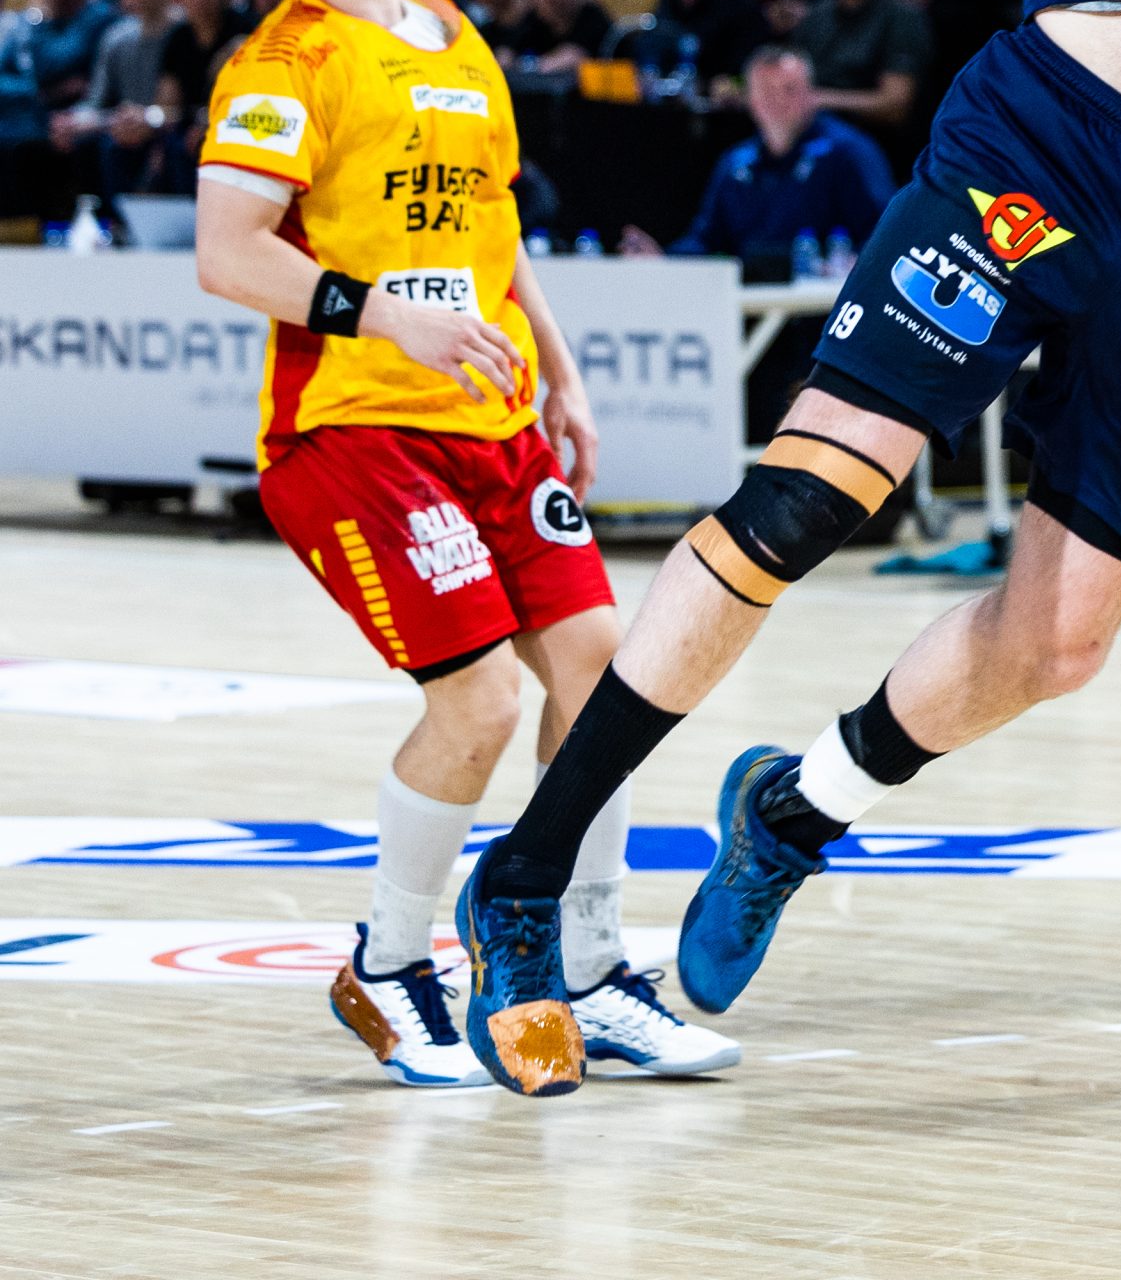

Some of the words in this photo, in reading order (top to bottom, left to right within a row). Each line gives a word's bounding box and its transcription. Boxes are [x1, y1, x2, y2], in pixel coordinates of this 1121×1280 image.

[909, 246, 1001, 317] JYTAS
[0, 317, 258, 371] KANDAT
[828, 301, 864, 340] 19
[883, 303, 968, 365] www.jytas.dk
[554, 499, 578, 525] Z
